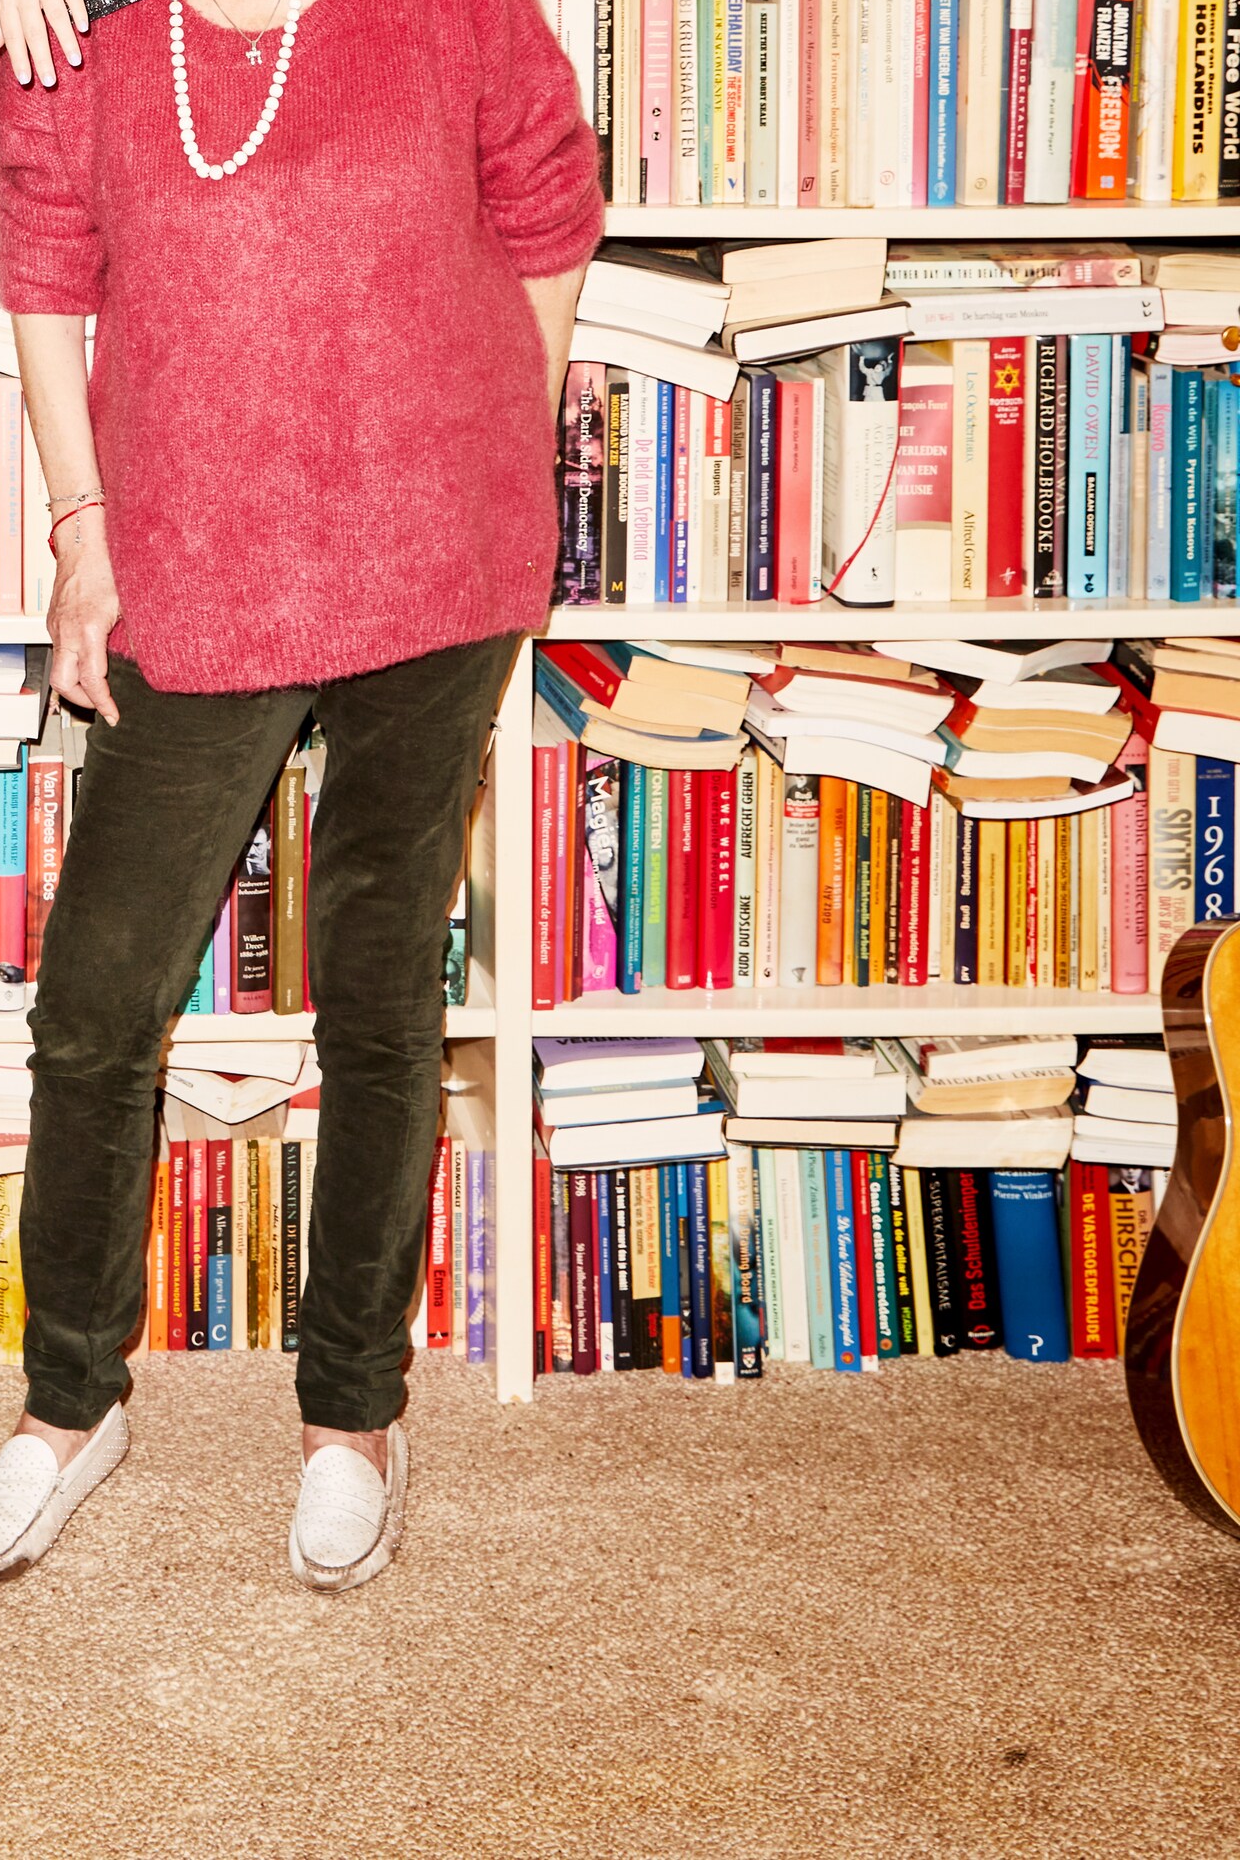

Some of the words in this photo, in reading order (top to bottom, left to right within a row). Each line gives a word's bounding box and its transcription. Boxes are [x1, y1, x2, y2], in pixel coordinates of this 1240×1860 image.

[726, 14, 743, 73] HALLIDAY
[1192, 4, 1207, 154] HOLLANDITIS
[1086, 345, 1100, 398] DAVID
[1039, 345, 1055, 432] RICHARD
[1084, 404, 1099, 459] OWEN
[1037, 437, 1054, 554] HOLBROOKE
[44, 770, 58, 799] Van
[741, 771, 754, 804] GEHEN
[42, 803, 59, 843] Drees
[720, 790, 731, 826] UWE
[740, 806, 753, 859] AUFRECHT
[42, 847, 57, 870] tot
[718, 836, 730, 893] WESEL
[1152, 808, 1193, 891] SIXTIES
[42, 874, 57, 901] Bos
[738, 894, 752, 947] DUTSCHKE
[242, 935, 267, 943] Willem
[245, 942, 264, 950] Drees
[737, 952, 750, 977] RUDI
[870, 1181, 881, 1214] Gaat
[1082, 1193, 1096, 1212] DE
[872, 1215, 882, 1231] de
[893, 1210, 903, 1227] Als
[894, 1228, 904, 1242] de
[872, 1232, 884, 1261] elite
[895, 1244, 906, 1275] dollar
[929, 1181, 951, 1311] SUPERKAPITALISME
[875, 1261, 886, 1284] ons
[898, 1277, 909, 1296] valt
[1082, 1214, 1100, 1344] VASTGOEDFRAUDE
[876, 1285, 892, 1337] redden?
